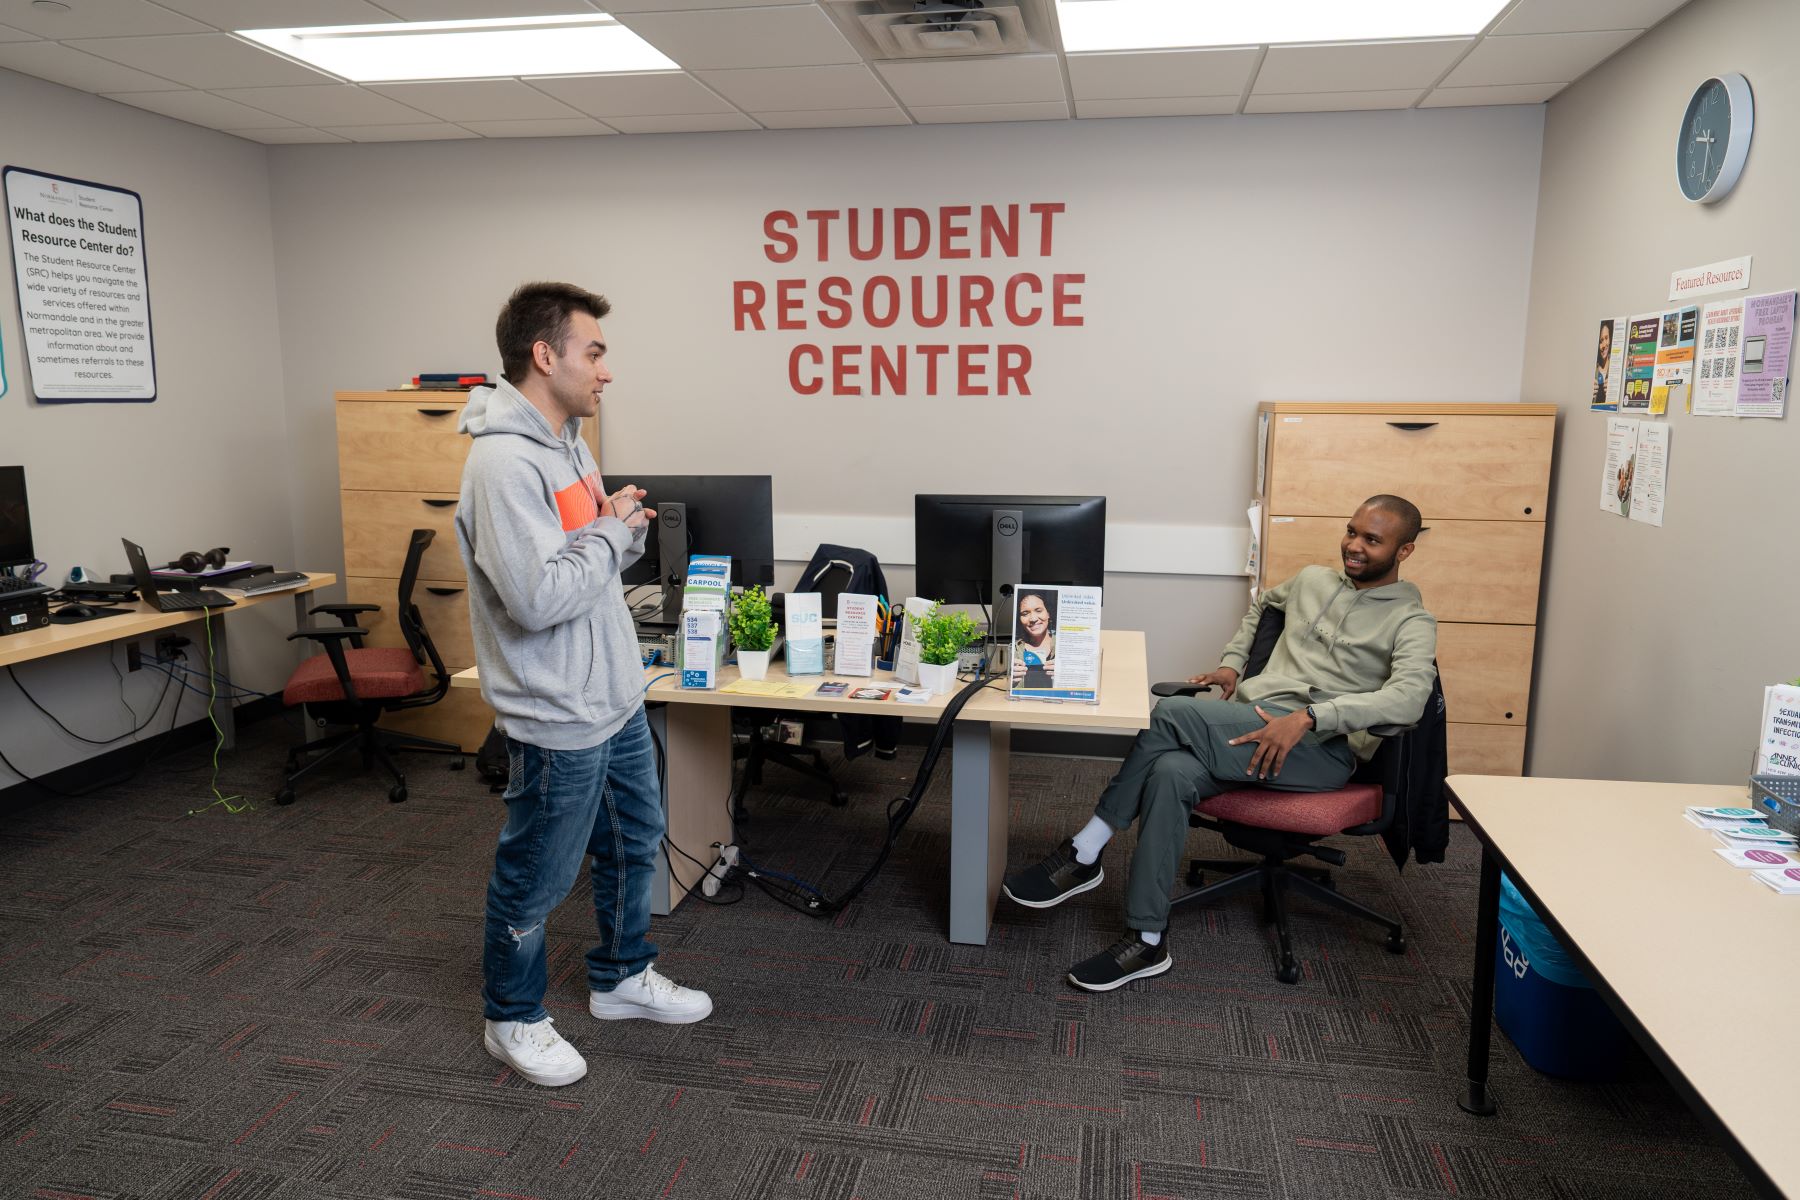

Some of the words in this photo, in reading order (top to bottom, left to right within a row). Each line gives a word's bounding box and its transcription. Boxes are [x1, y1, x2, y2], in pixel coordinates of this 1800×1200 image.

[1692, 116, 1702, 134] 10
[1690, 160, 1695, 178] 8
[14, 206, 45, 223] What
[48, 212, 75, 228] does
[78, 218, 94, 231] the
[97, 221, 137, 238] Student
[763, 203, 1065, 263] STUDENT
[22, 230, 76, 248] Resource
[80, 238, 113, 254] Center
[116, 244, 134, 257] do?
[24, 252, 40, 262] The
[42, 254, 74, 267] Student
[76, 260, 111, 271] Resource
[113, 264, 136, 274] Center
[26, 268, 50, 280] (SRC)
[52, 270, 74, 280] helps
[92, 276, 124, 286] navigate
[1676, 271, 1705, 291] Featured
[1706, 268, 1744, 285] Resources
[27, 282, 46, 292] wide
[48, 285, 76, 296] variety
[78, 288, 87, 296] of
[89, 290, 126, 300] resources
[127, 292, 140, 301] and
[42, 298, 76, 308] services
[78, 300, 106, 311] offered
[108, 304, 130, 312] within
[733, 272, 1086, 331] RESOURCE
[26, 312, 78, 323] Normandale
[80, 316, 94, 324] and
[105, 317, 118, 326] the
[120, 319, 144, 328] greater
[1755, 307, 1769, 317] FREE
[1758, 314, 1784, 326] PROGRAM
[30, 326, 82, 338] metropolitan
[105, 330, 118, 338] We
[120, 332, 144, 342] provide
[47, 341, 94, 351] information
[96, 344, 117, 353] about
[120, 345, 133, 353] and
[37, 355, 80, 364] sometimes
[81, 356, 114, 366] referrals
[126, 358, 144, 367] these
[788, 344, 1032, 396] CENTER
[74, 370, 113, 380] resources.
[688, 578, 722, 586] CARPOOL
[1771, 752, 1798, 764] ANNEX
